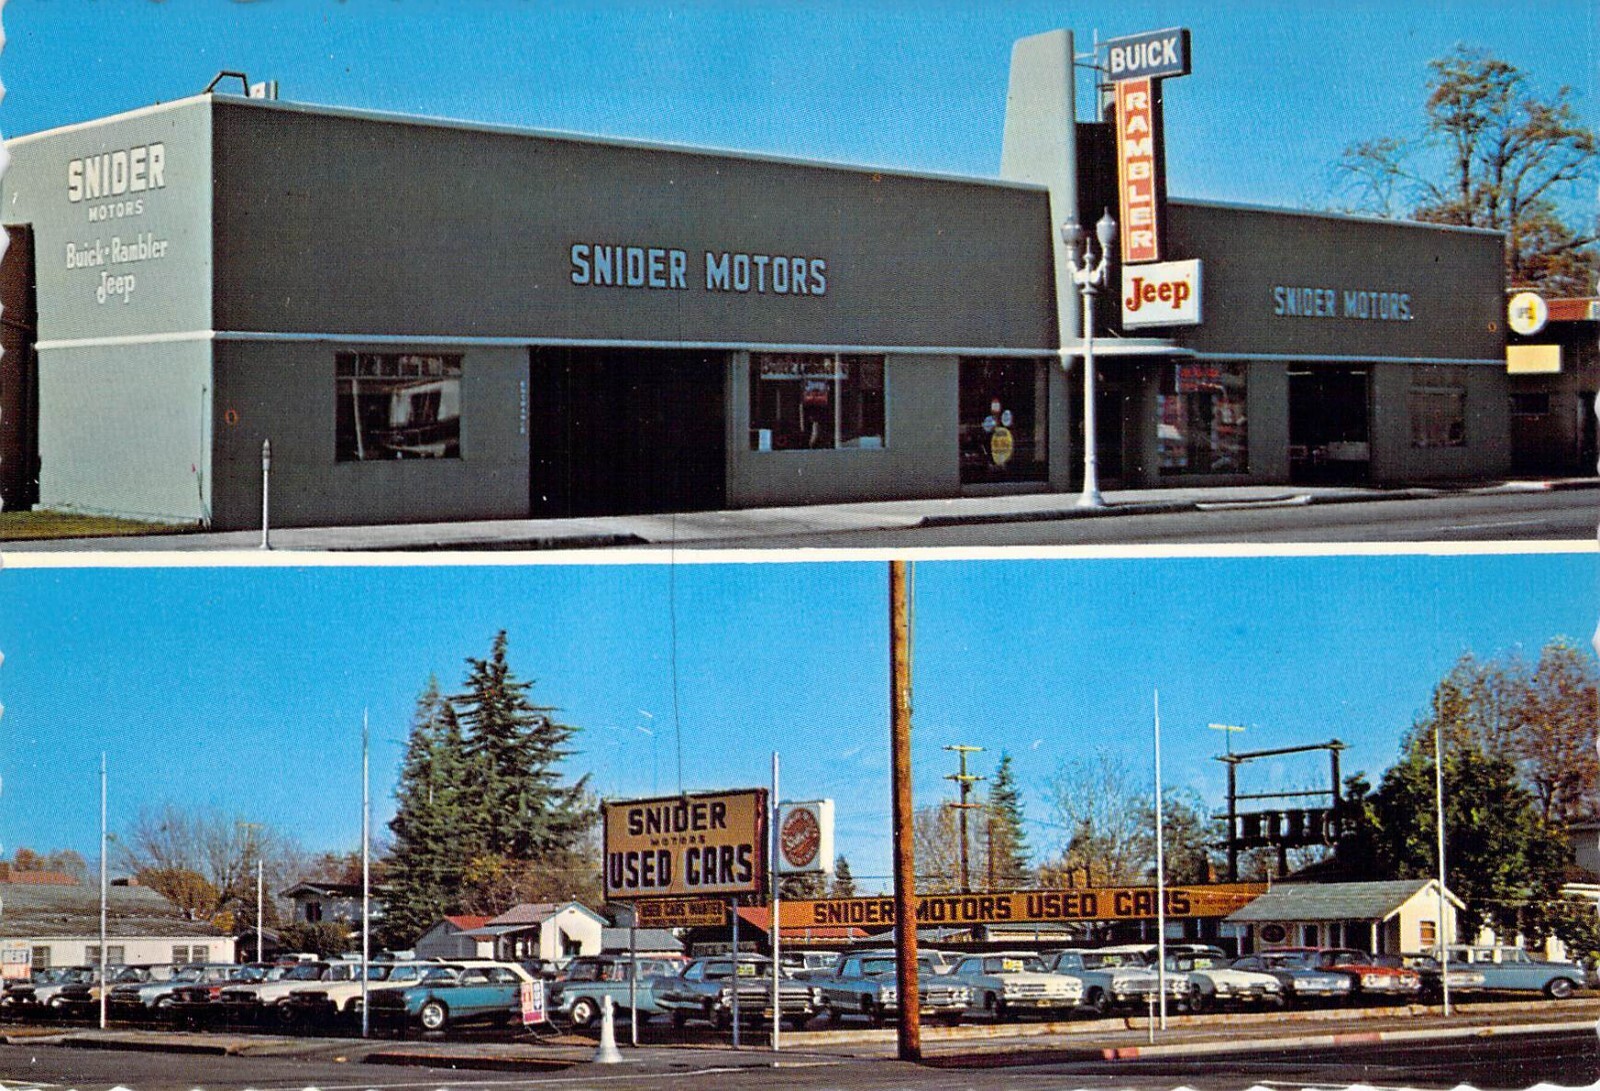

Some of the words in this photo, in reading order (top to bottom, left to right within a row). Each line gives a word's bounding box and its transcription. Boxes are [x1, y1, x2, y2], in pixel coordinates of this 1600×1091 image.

[1109, 37, 1178, 73] BUICK
[67, 141, 165, 203] SNIDER
[1125, 92, 1154, 249] RAMBLER
[88, 199, 144, 222] MOTORS
[97, 269, 135, 304] Jeep
[570, 243, 688, 290] SNIDER
[705, 251, 828, 296] MOTORS
[1125, 277, 1190, 311] Jeep
[1273, 286, 1337, 318] SNIDER
[1343, 290, 1411, 321] MOTORS
[628, 803, 726, 836] SNIDER
[650, 835, 706, 846] MOTORS
[608, 848, 673, 889] USED
[684, 844, 753, 885] CARS
[813, 899, 896, 923] SNIDER
[914, 896, 1012, 922] MOTORS
[1027, 891, 1098, 918] USED
[1113, 888, 1192, 916] CARS
